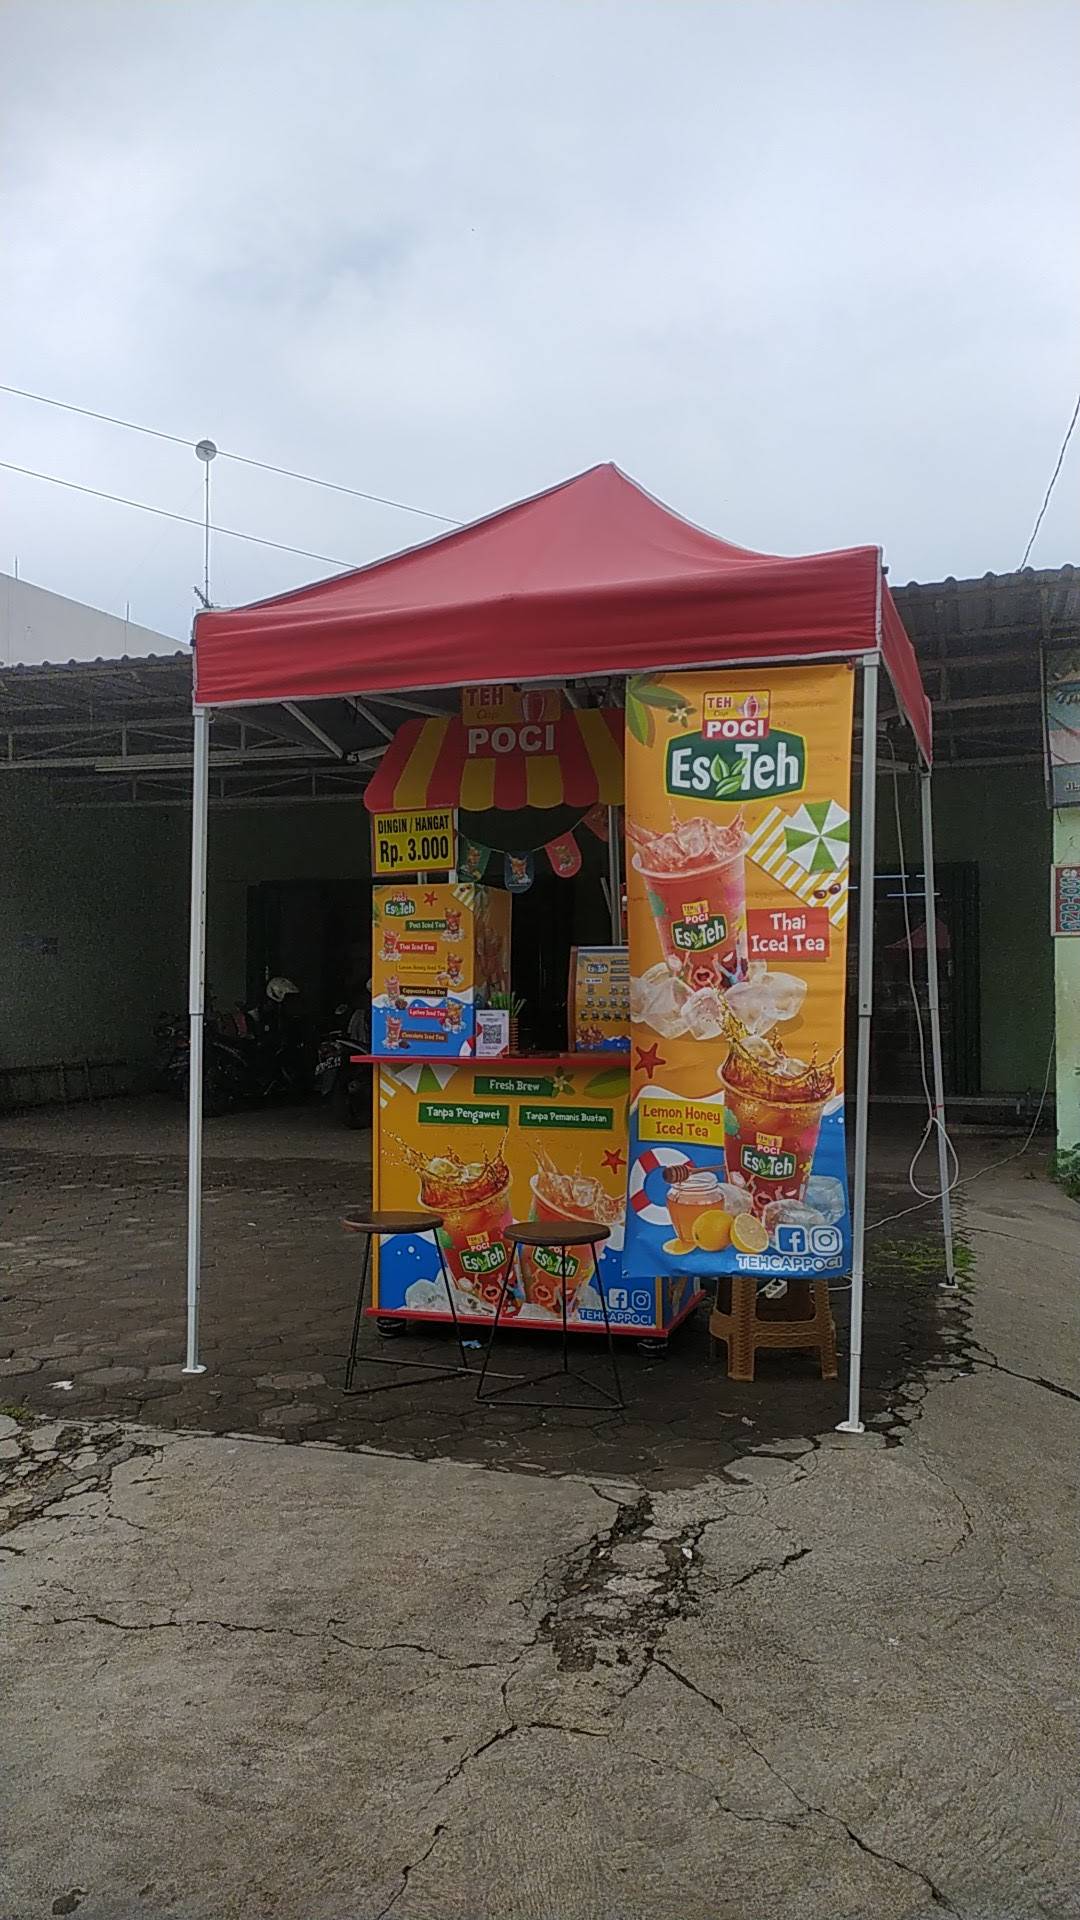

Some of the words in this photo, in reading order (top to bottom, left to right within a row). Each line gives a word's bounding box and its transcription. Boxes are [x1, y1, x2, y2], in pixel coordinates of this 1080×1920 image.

[465, 687, 504, 706] TEH
[706, 696, 732, 709] TEH
[706, 719, 765, 738] POCI
[468, 724, 554, 754] POCI
[378, 818, 407, 834] DINGIN
[409, 816, 413, 833] /
[415, 815, 449, 831] HANGAT
[380, 840, 403, 867] Rp.
[408, 836, 449, 861] 3.000
[685, 912, 709, 924] POCI
[769, 912, 806, 931] Thai
[751, 935, 788, 952] Iced
[792, 934, 825, 952] Tea
[489, 1079, 515, 1091] Fresh
[516, 1080, 540, 1091] Brew
[427, 1106, 454, 1120] Tanpa
[455, 1107, 501, 1124] Pengawet
[526, 1111, 549, 1122] Tanpa
[550, 1112, 579, 1122] Pemanis
[581, 1113, 607, 1123] Buatan
[643, 1104, 682, 1119] Lemon
[685, 1106, 721, 1124] Honey
[656, 1121, 683, 1136] Iced
[686, 1123, 709, 1138] Tea
[757, 1144, 780, 1155] POCI
[471, 1242, 490, 1251] POCI
[737, 1254, 843, 1271] TEHCAPPOCI
